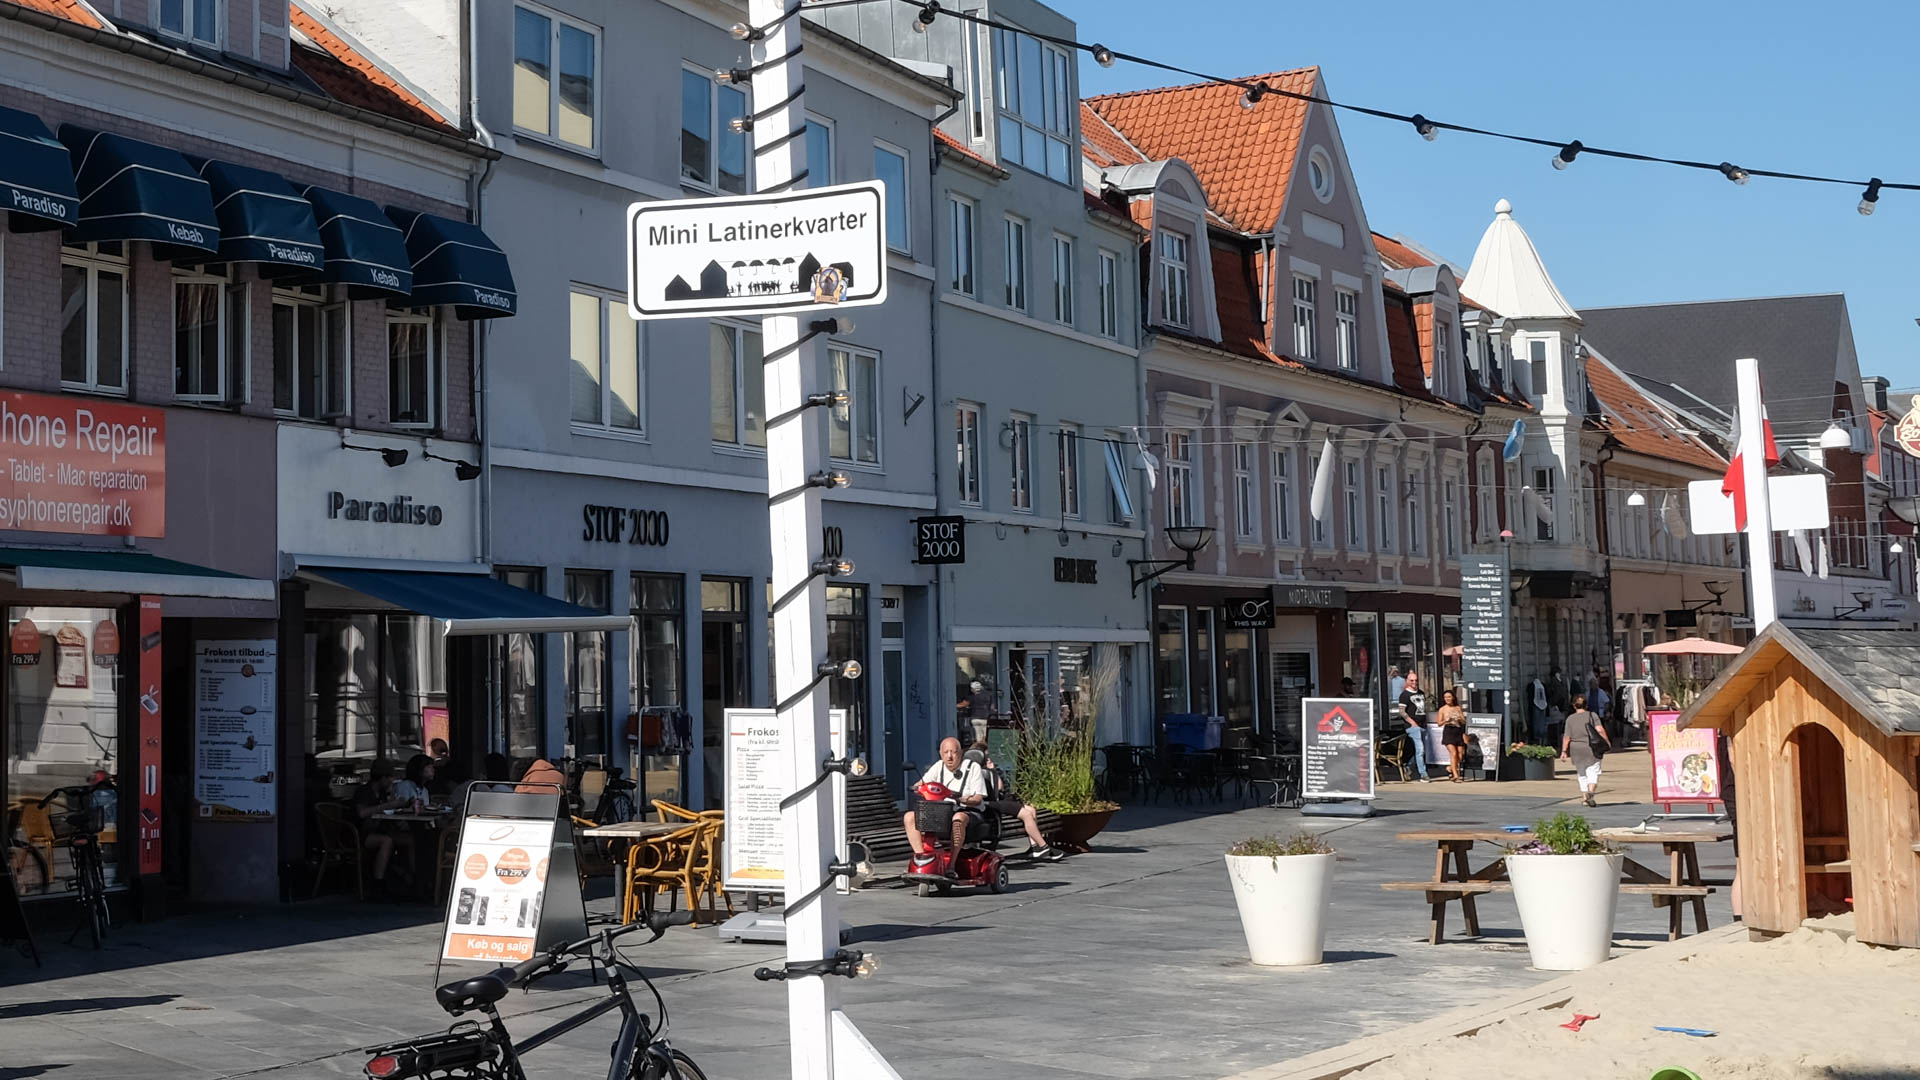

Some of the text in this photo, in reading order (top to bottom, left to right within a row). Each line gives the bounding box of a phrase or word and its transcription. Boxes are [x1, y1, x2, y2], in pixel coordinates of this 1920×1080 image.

[12, 189, 66, 218] Paradiso
[168, 223, 204, 244] Kebab
[649, 211, 867, 246] Mini Latinerkvarter
[268, 243, 315, 264] Paradiso
[371, 268, 399, 287] Kebab
[474, 289, 510, 308] Paradiso
[76, 409, 157, 464] Repair
[8, 458, 45, 483] Tablet
[57, 463, 86, 486] iMac
[89, 468, 147, 492] reparation
[0, 493, 132, 530] syphonerepair.dk
[328, 491, 443, 526] Paradiso
[583, 504, 670, 547] STOF 2000
[921, 522, 959, 540] STOF
[922, 541, 960, 558] 2000
[12, 655, 22, 664] Fra
[95, 655, 104, 664] Fra
[204, 648, 265, 656] Frokost tilbud
[748, 728, 779, 736] Frokos
[497, 868, 508, 876] Fra
[467, 938, 529, 954] Køb og salg
